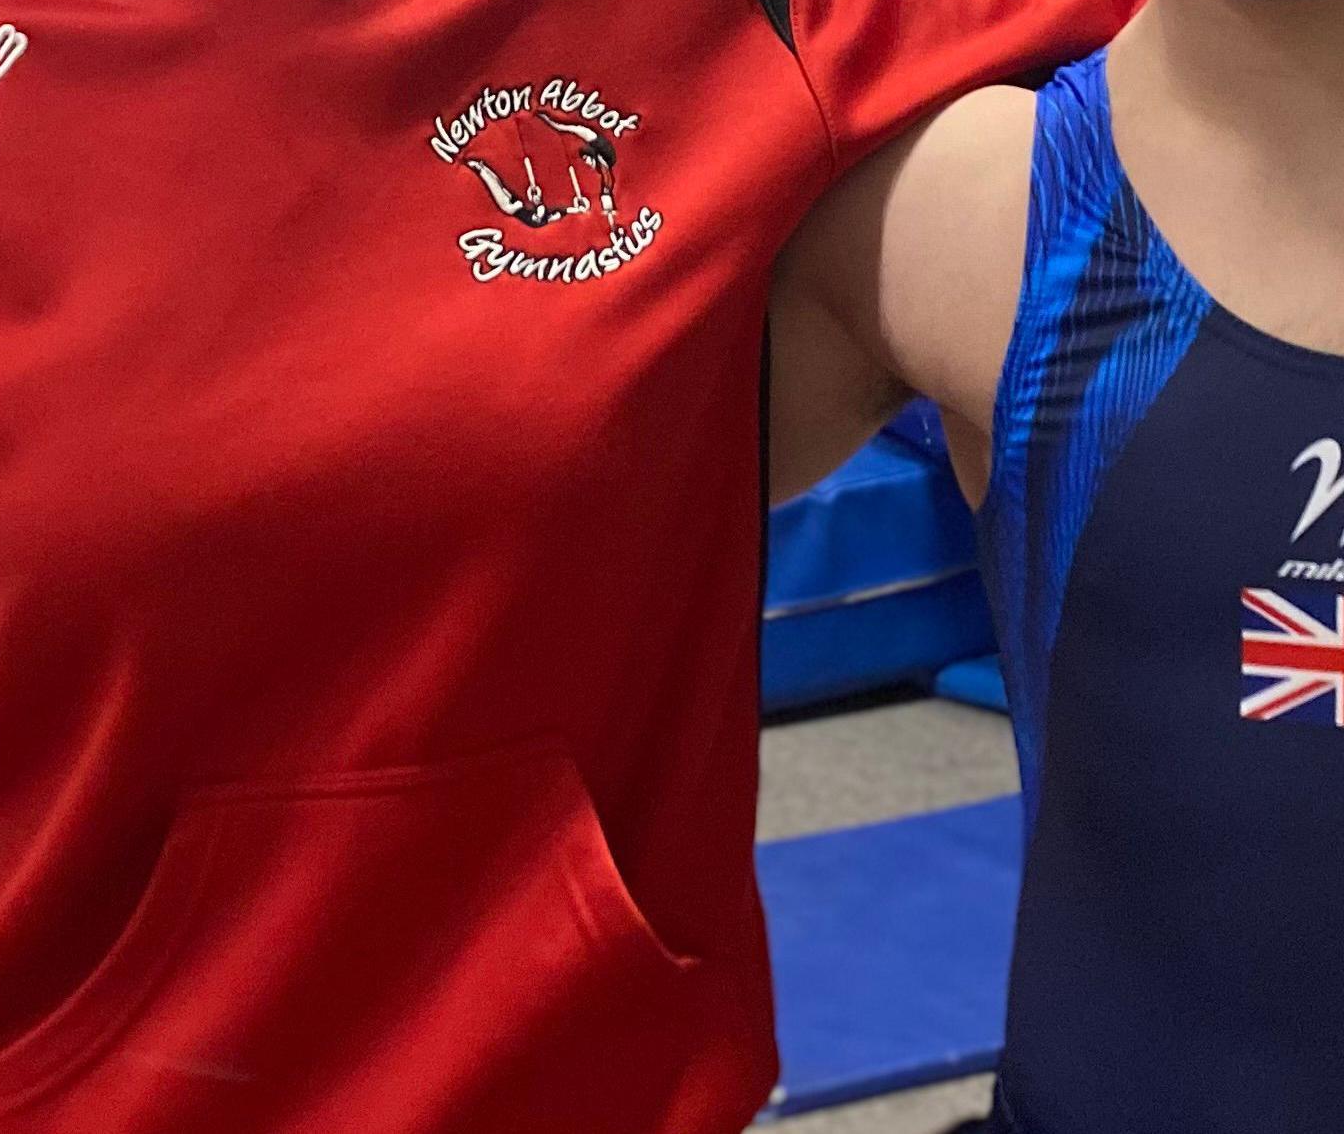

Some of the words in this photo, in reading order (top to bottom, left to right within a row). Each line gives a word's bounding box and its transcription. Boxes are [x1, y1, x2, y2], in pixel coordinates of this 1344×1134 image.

[430, 85, 532, 164] Newton
[539, 78, 640, 138] Abbot
[458, 206, 663, 283] Gymnastics
